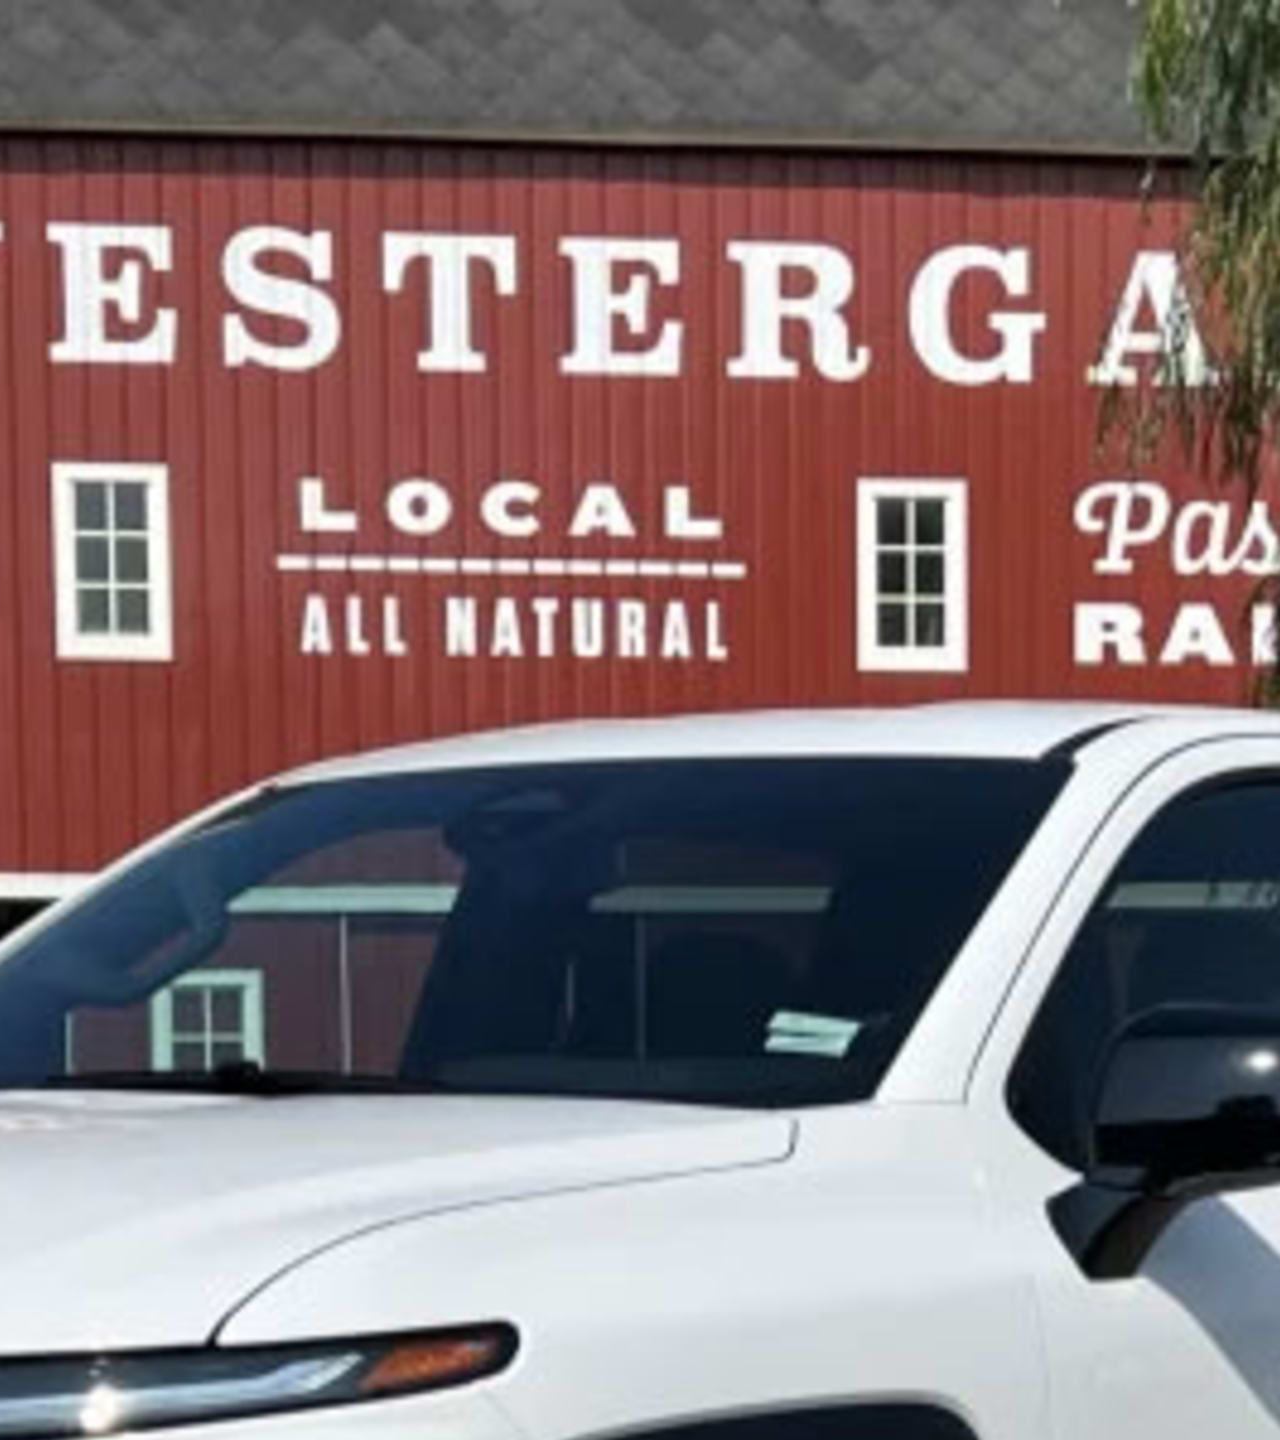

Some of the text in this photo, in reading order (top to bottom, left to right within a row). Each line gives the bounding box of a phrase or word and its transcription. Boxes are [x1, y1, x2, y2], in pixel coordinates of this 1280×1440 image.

[298, 476, 724, 541] LOCAL
[300, 594, 728, 662] ALL NATURAL
